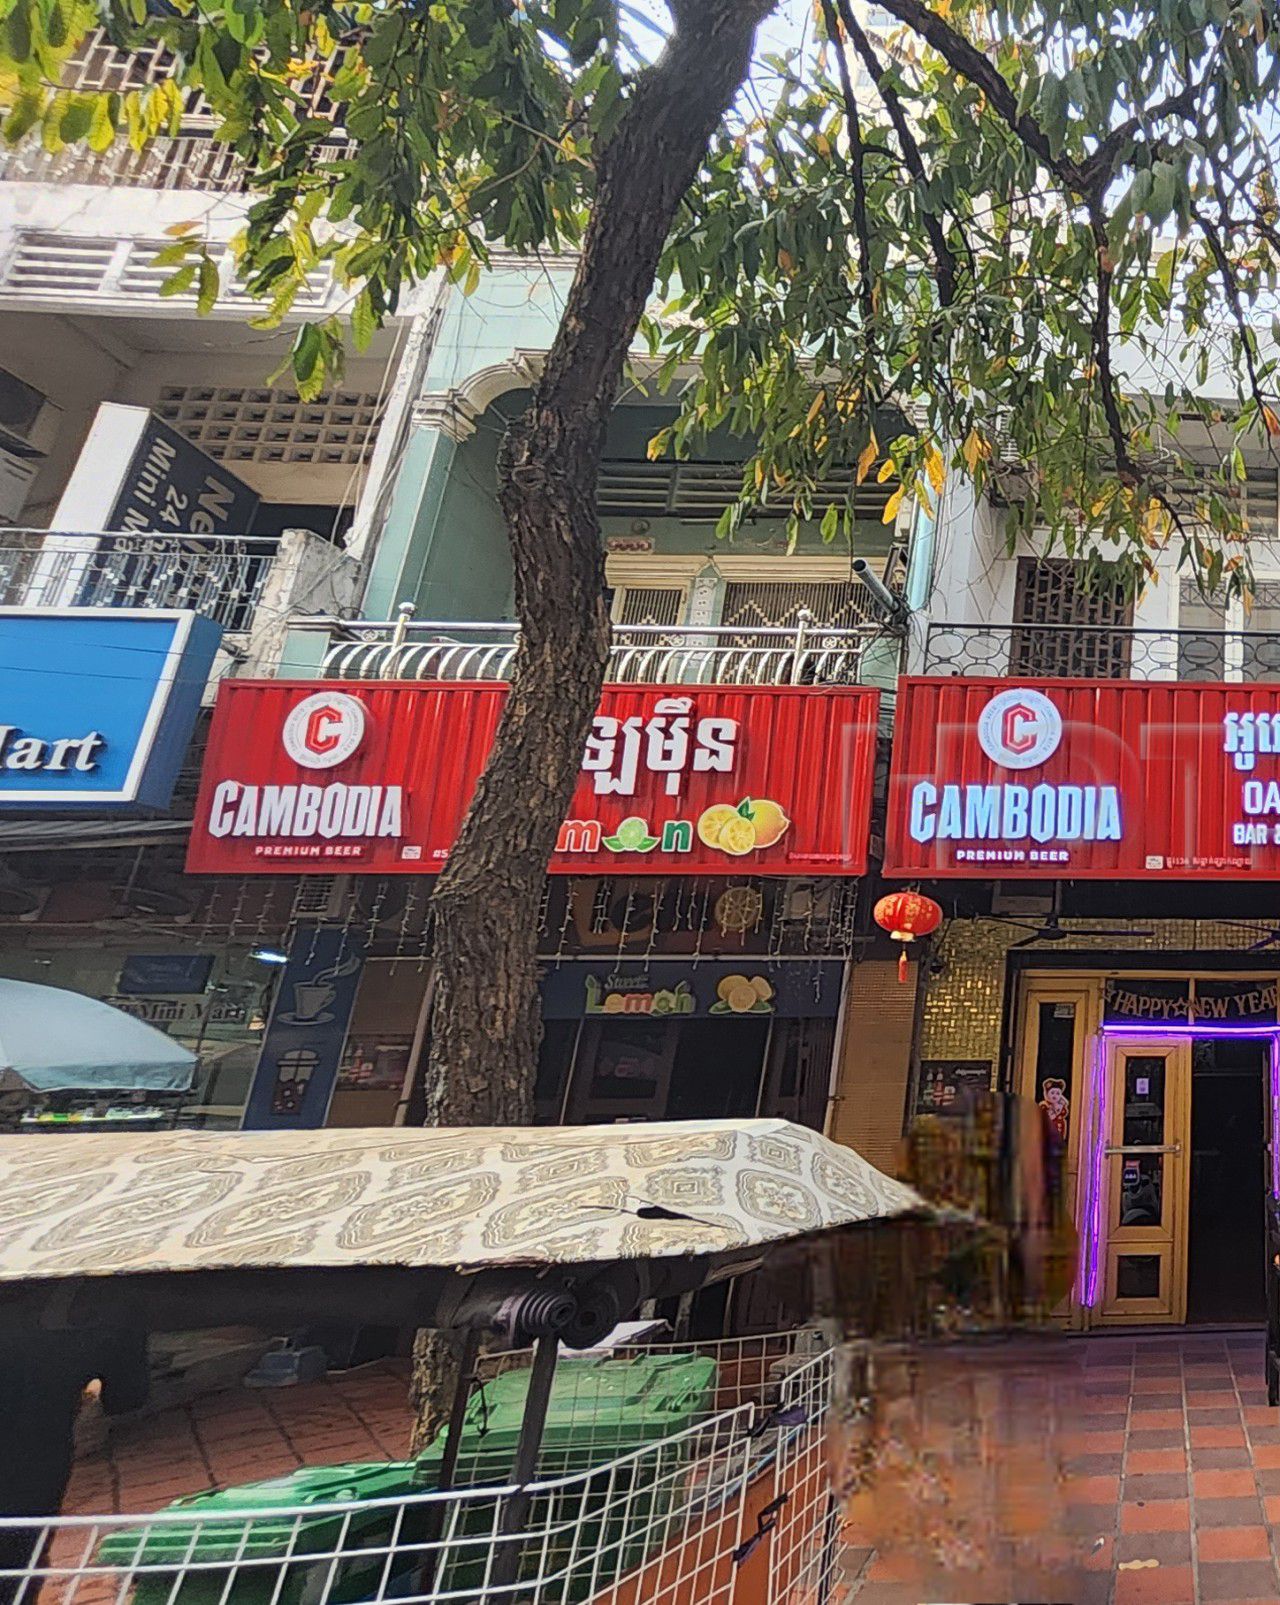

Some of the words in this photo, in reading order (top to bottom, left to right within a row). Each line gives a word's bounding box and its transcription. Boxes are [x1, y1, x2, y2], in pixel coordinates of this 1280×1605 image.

[133, 437, 177, 509] Mini
[159, 484, 188, 527] 24
[0, 726, 103, 772] art
[208, 779, 403, 839] CAMBODIA
[909, 781, 1123, 844] CAMBODIA
[254, 845, 320, 857] PREMIUM
[324, 845, 362, 857] BEER
[956, 850, 1026, 862] PREMIUM
[1029, 850, 1069, 862] BEER
[1233, 824, 1268, 846] BAR
[1113, 989, 1175, 1020] HAPPY
